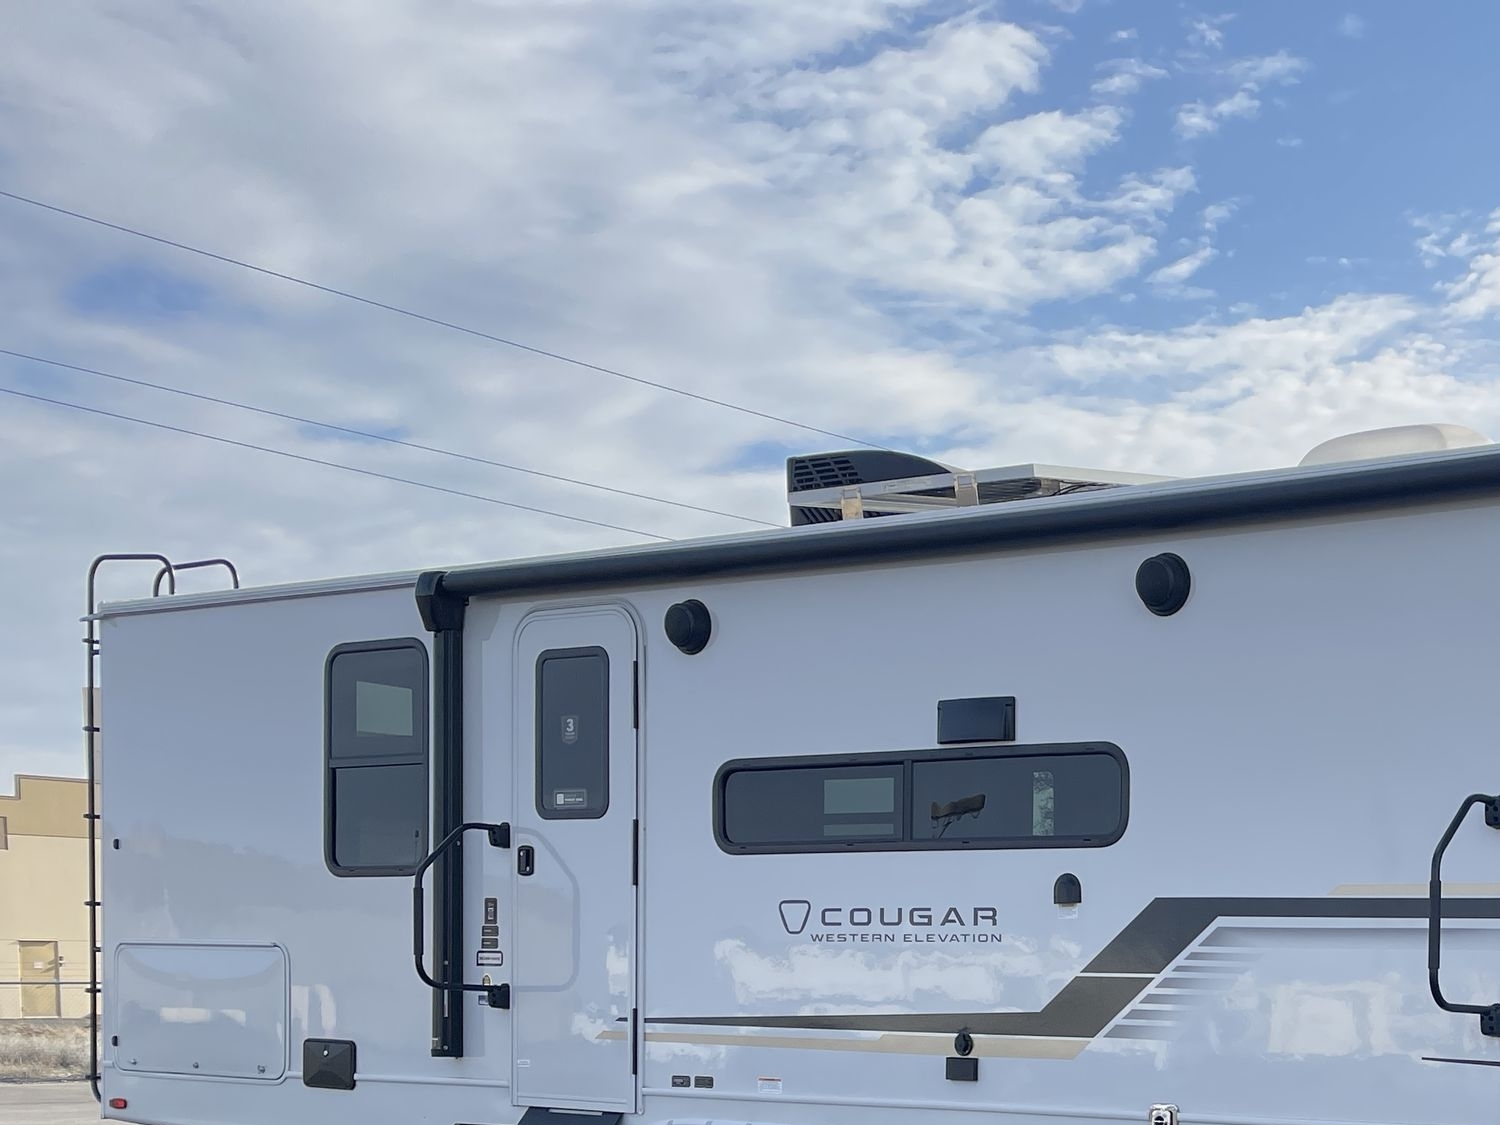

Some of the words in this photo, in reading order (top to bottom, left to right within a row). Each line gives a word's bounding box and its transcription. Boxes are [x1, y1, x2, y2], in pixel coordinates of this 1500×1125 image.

[566, 718, 574, 732] 3
[821, 906, 998, 927] COUGAR
[810, 933, 896, 943] WESTERN
[903, 933, 1003, 943] ELEVATION
